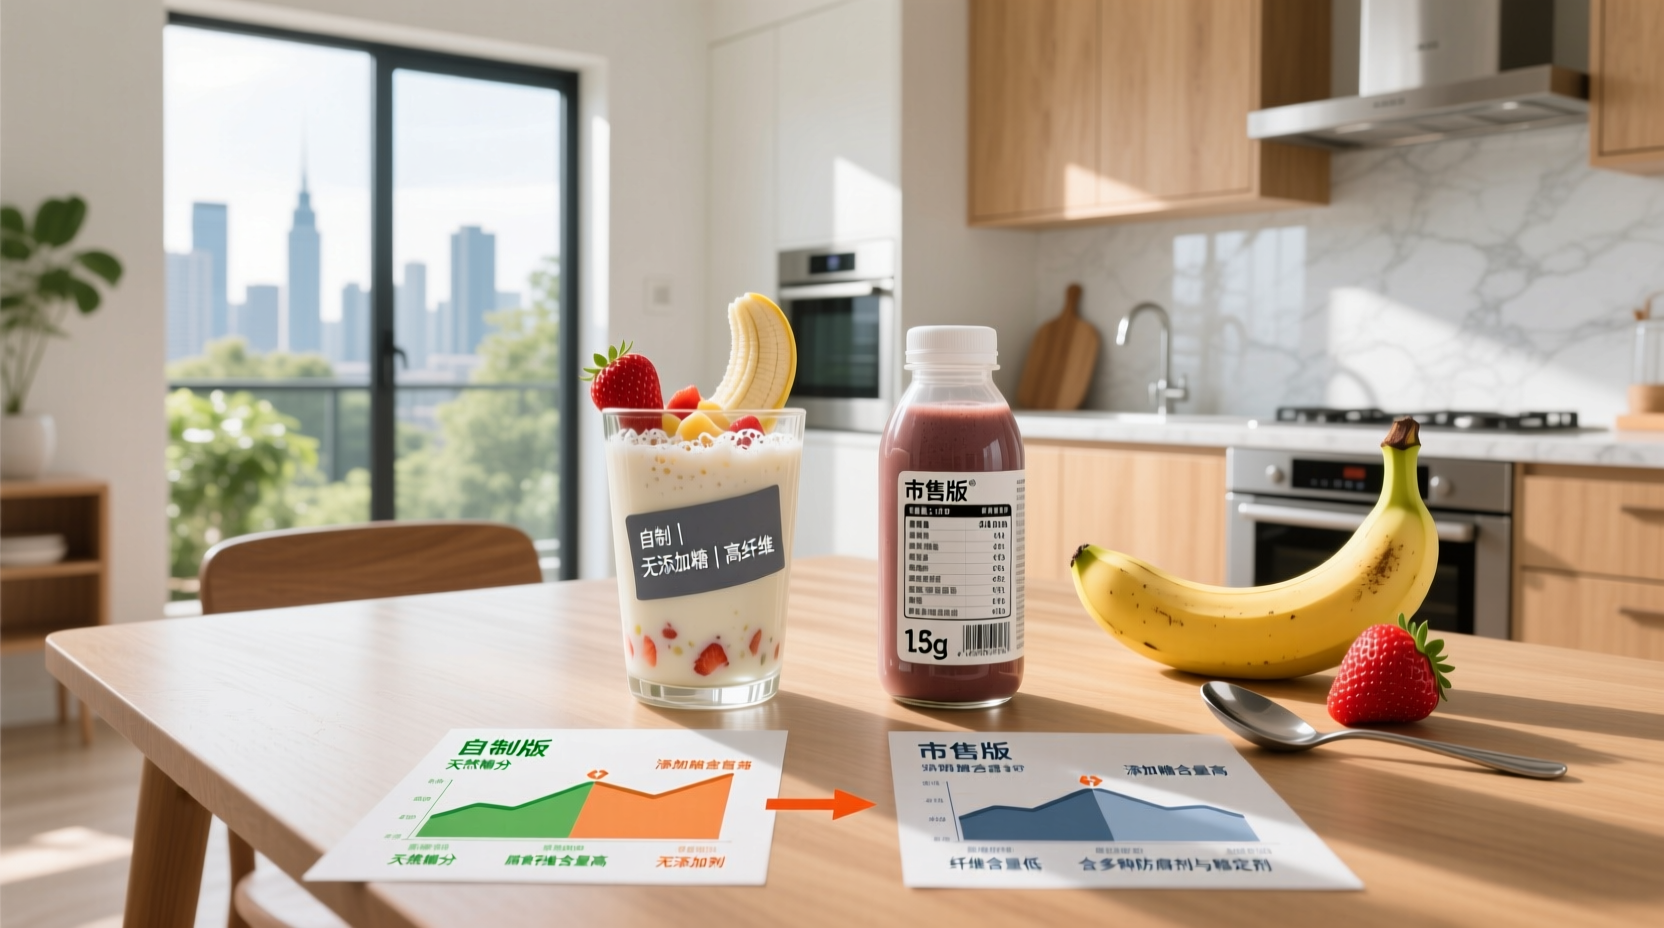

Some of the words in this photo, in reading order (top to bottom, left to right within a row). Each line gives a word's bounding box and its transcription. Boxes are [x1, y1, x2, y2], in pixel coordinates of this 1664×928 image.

[905, 479, 967, 502] 市售版
[640, 525, 671, 550] 自制
[640, 548, 709, 578] 无添加糖
[724, 534, 775, 565] 高纤维
[458, 738, 552, 757] 自制版
[918, 741, 1012, 760] 市售版
